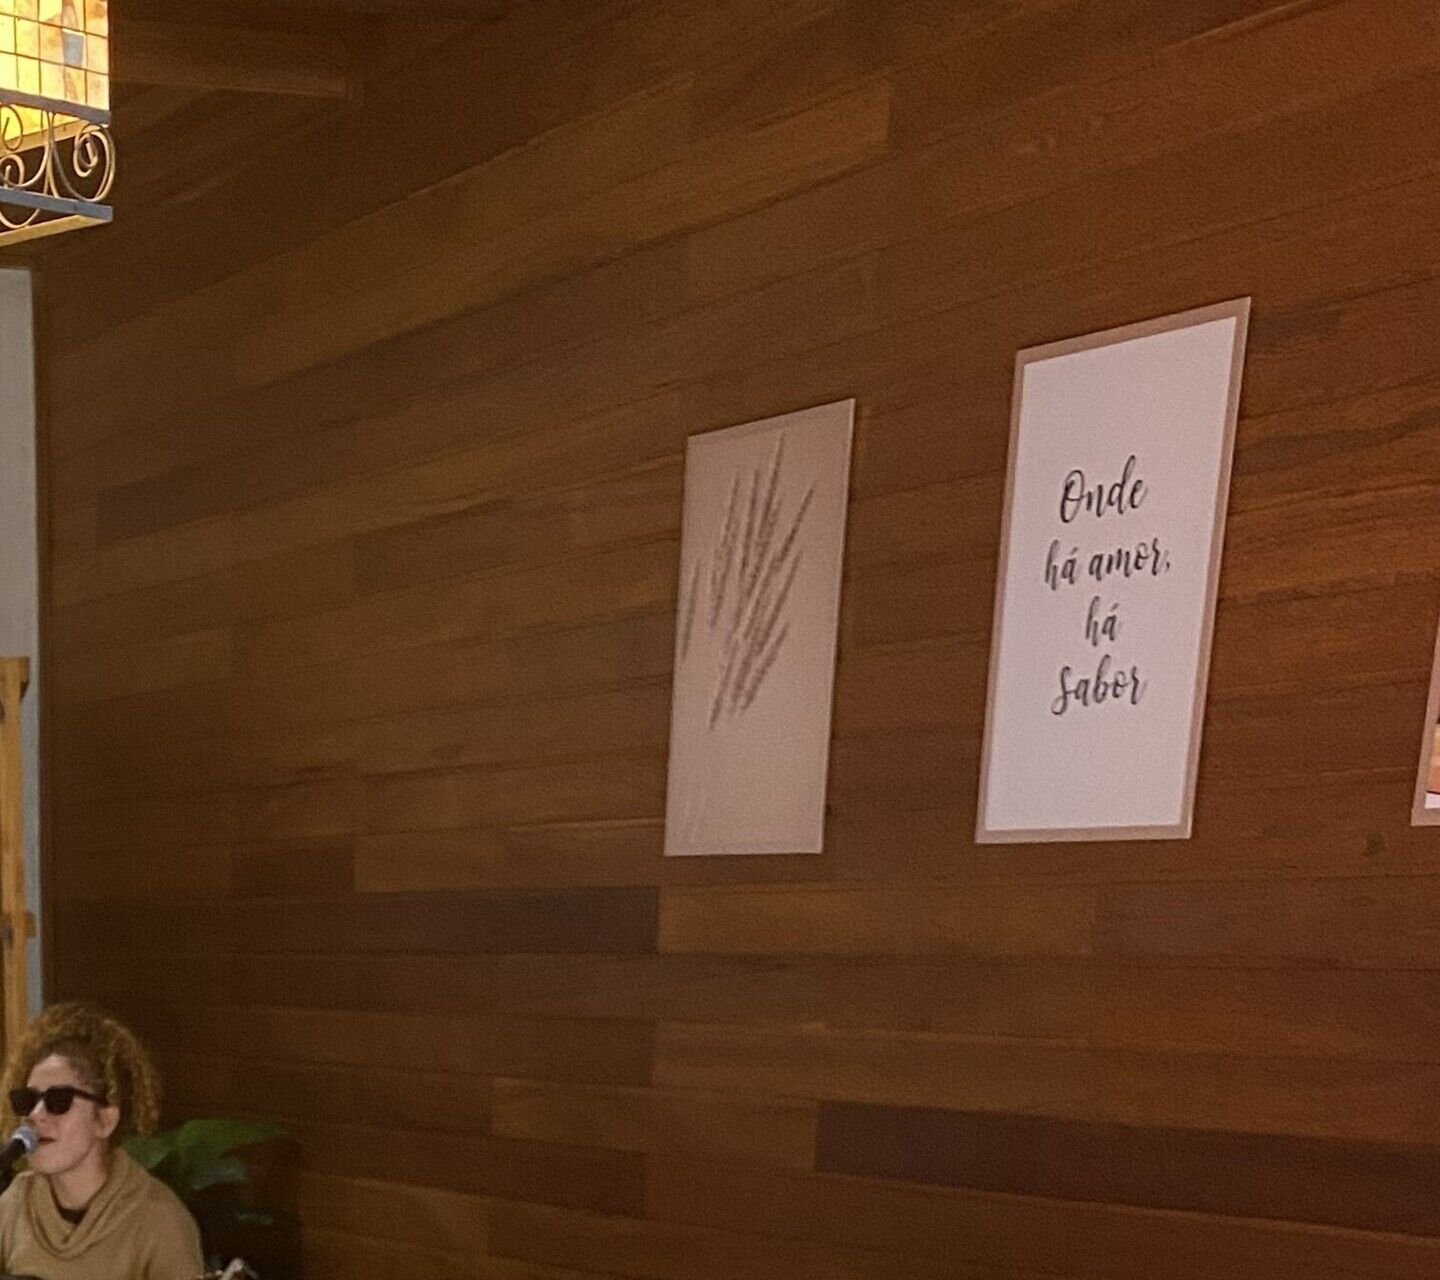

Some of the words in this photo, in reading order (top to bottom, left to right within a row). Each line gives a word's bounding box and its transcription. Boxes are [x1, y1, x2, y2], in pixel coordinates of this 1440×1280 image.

[1060, 454, 1147, 523] Onde
[1044, 539, 1079, 591] há
[1088, 537, 1171, 581] amor,
[1085, 596, 1121, 647] há
